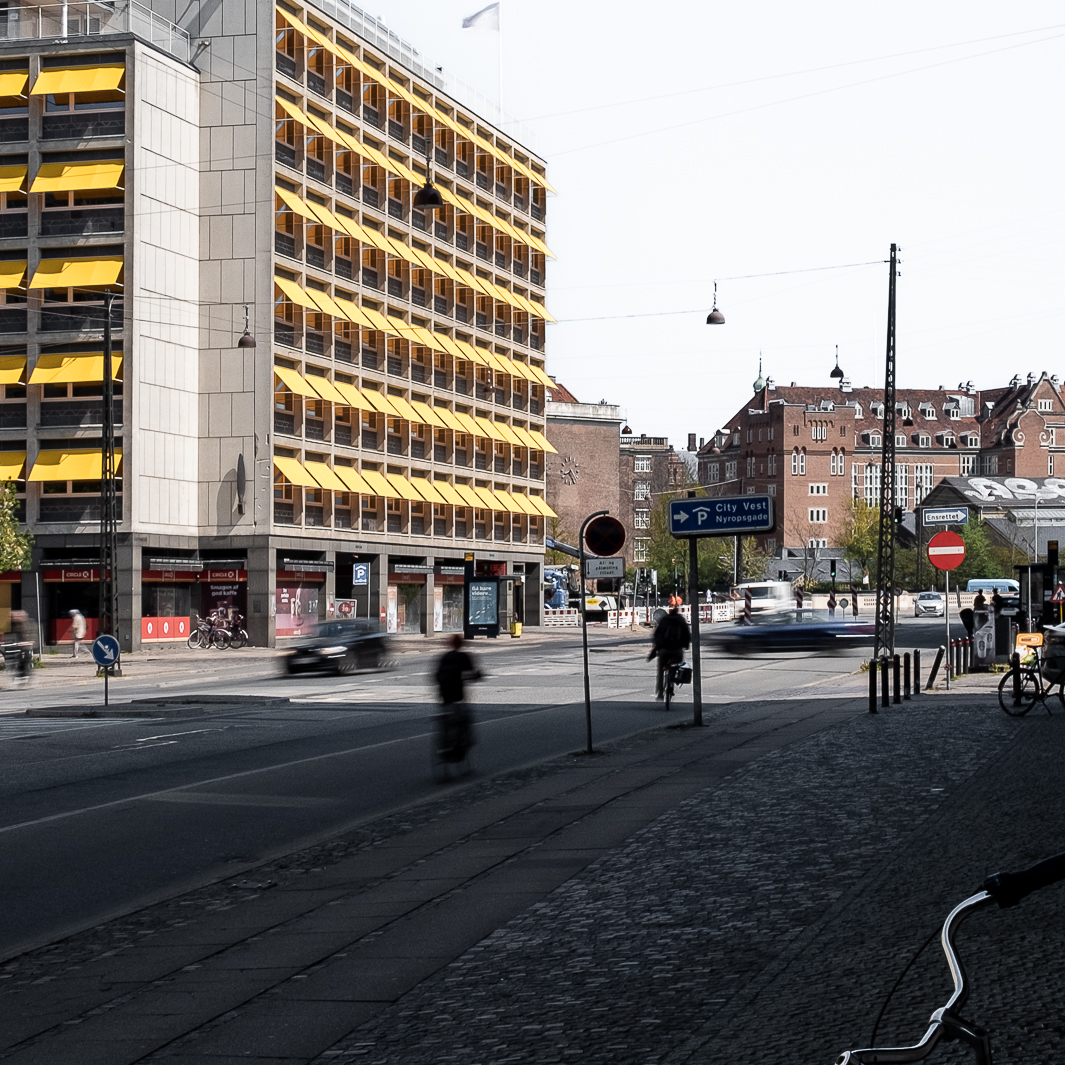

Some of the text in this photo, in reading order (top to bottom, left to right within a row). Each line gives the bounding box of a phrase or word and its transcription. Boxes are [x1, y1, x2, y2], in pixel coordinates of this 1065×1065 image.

[715, 501, 766, 513] City Vest
[697, 511, 708, 525] P
[716, 513, 768, 524] Nyropsgade
[357, 569, 365, 579] P
